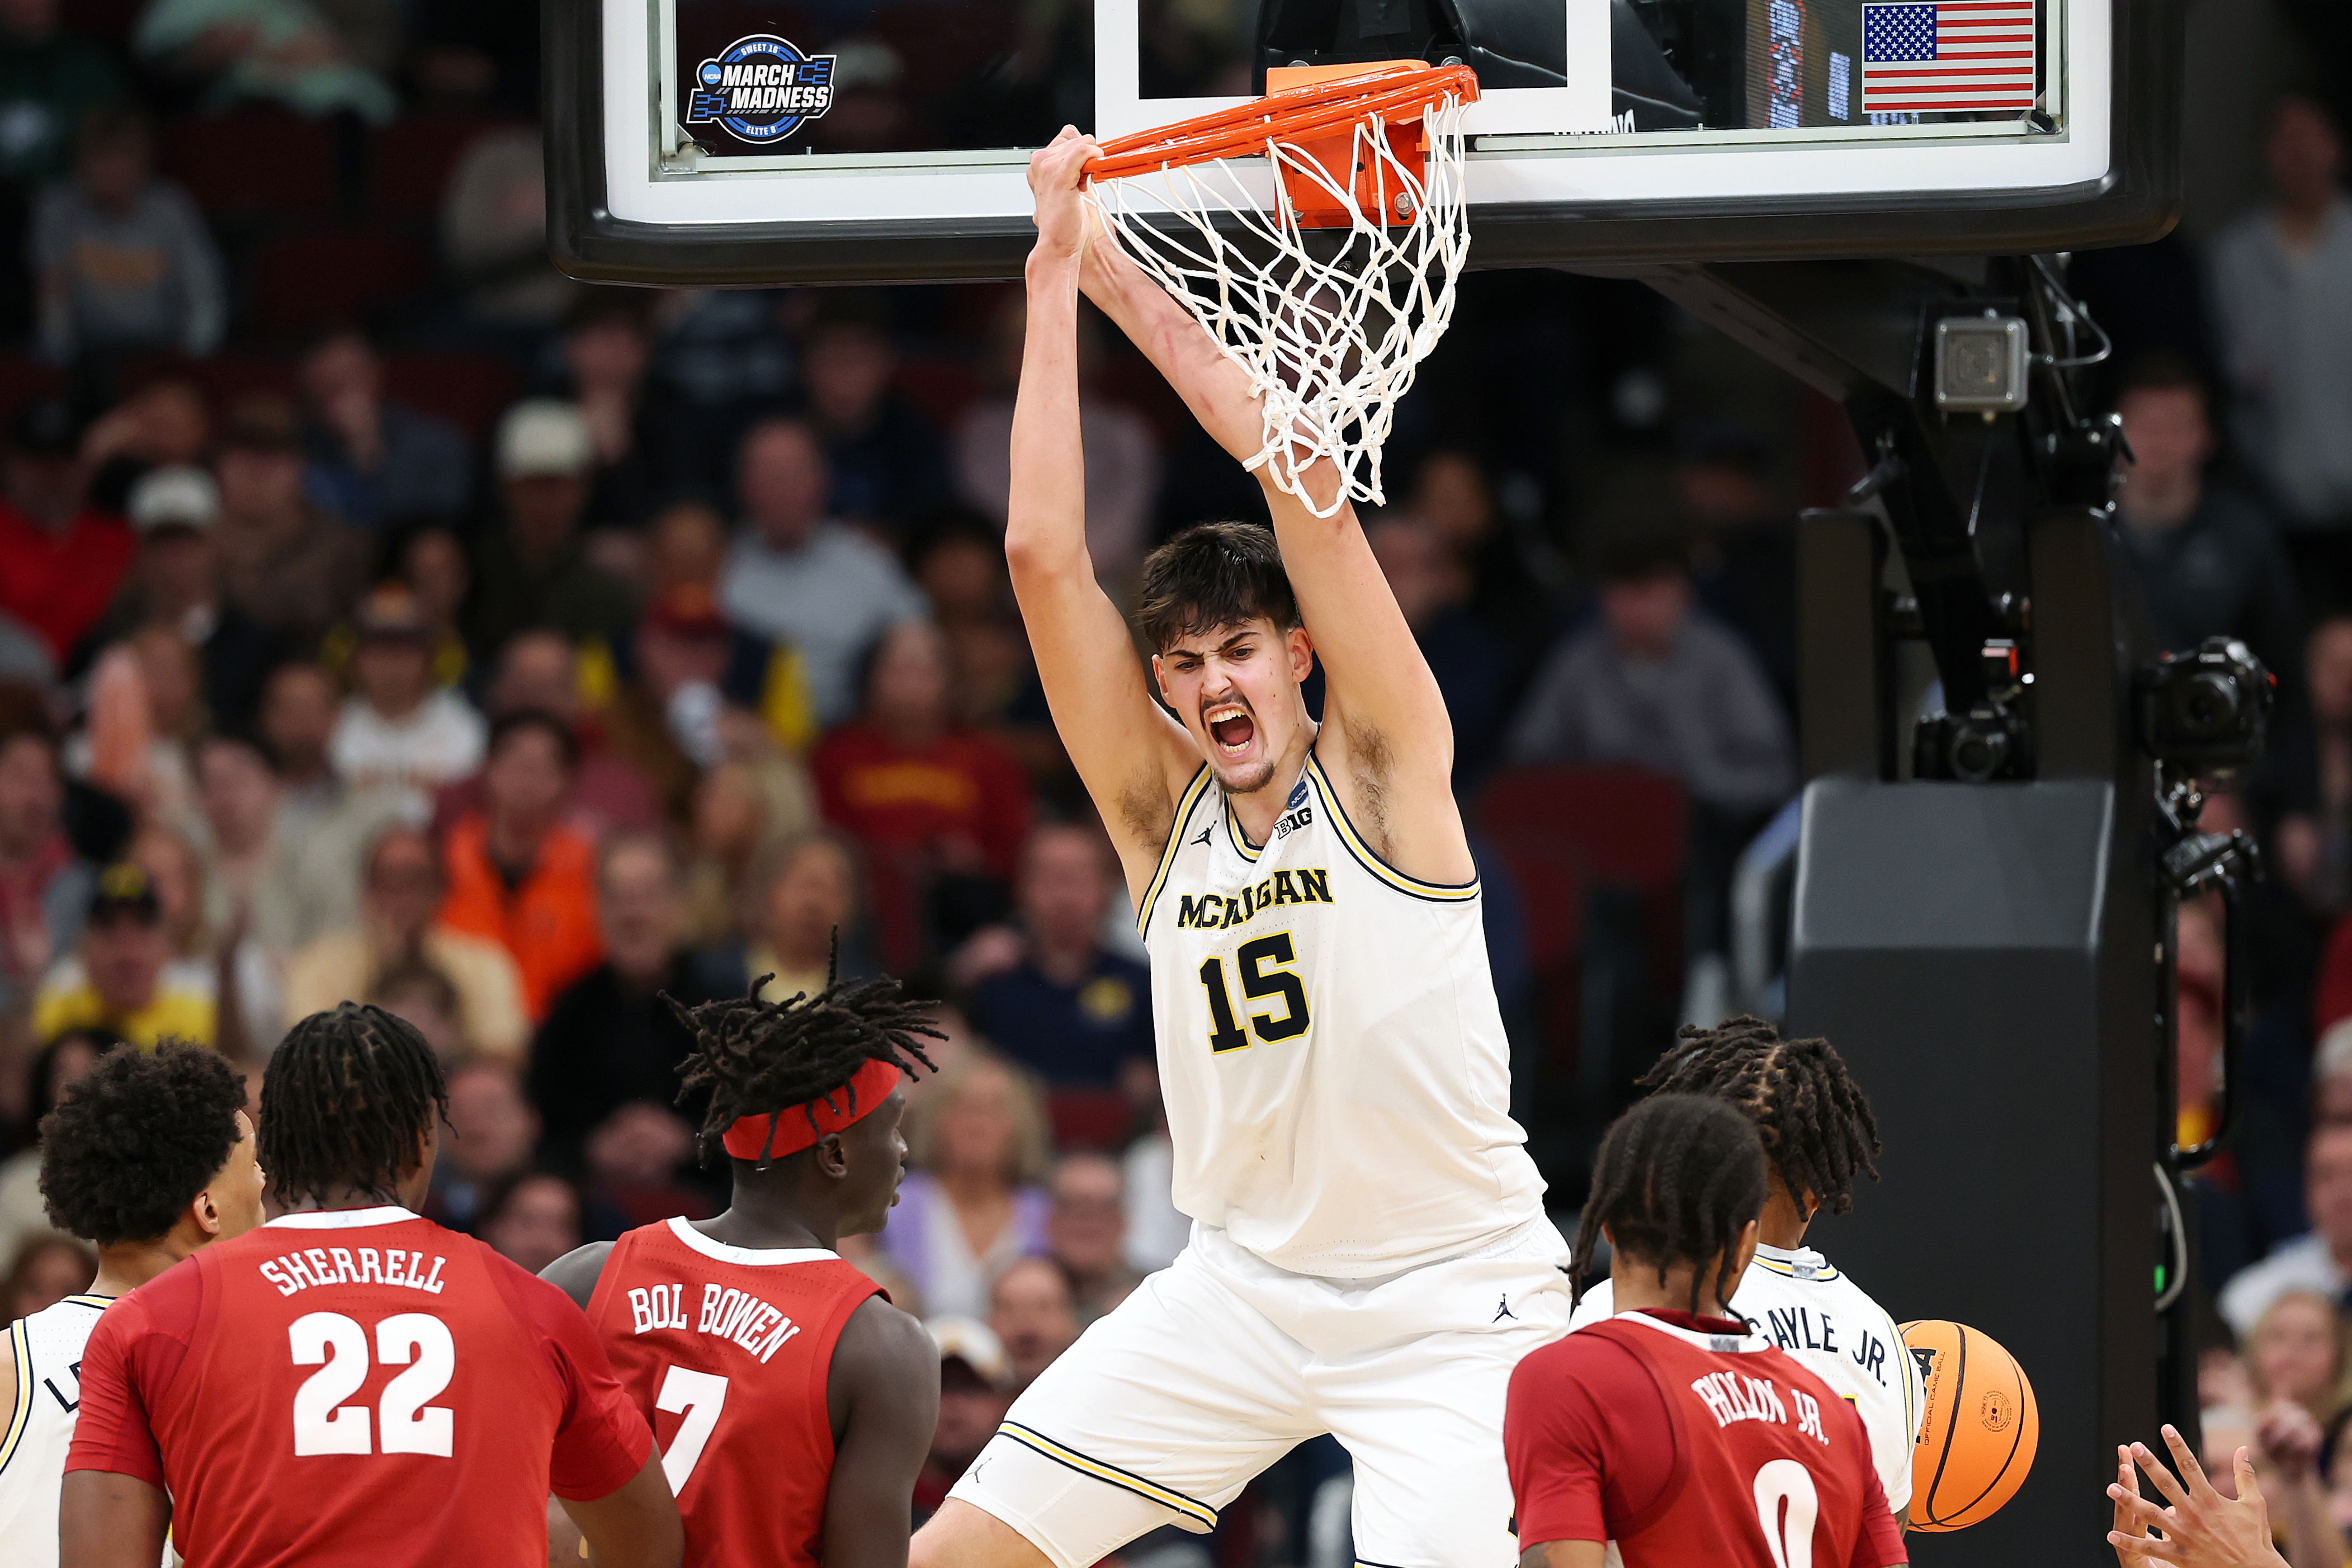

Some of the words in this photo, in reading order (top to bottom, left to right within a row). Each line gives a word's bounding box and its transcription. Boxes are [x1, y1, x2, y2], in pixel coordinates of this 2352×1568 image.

[722, 64, 795, 86] MARCH
[740, 44, 767, 56] SWEET
[768, 44, 778, 54] 16
[730, 87, 829, 108] MADNESS
[745, 125, 768, 135] ELITE
[770, 125, 776, 134] 8
[1199, 930, 1310, 1055] 15
[259, 1248, 447, 1297] SHERRELL
[627, 1283, 688, 1335] BOL
[697, 1283, 801, 1364] BOWEN
[288, 1311, 456, 1458] 22
[1852, 1329, 1887, 1387] JR.
[1791, 1388, 1830, 1446] JR.
[1924, 1402, 1934, 1446] OFFICIAL
[1930, 1373, 1940, 1400] GAME
[1936, 1352, 1945, 1372] BALL
[656, 1365, 729, 1499] 7
[1753, 1459, 1819, 1568] 0
